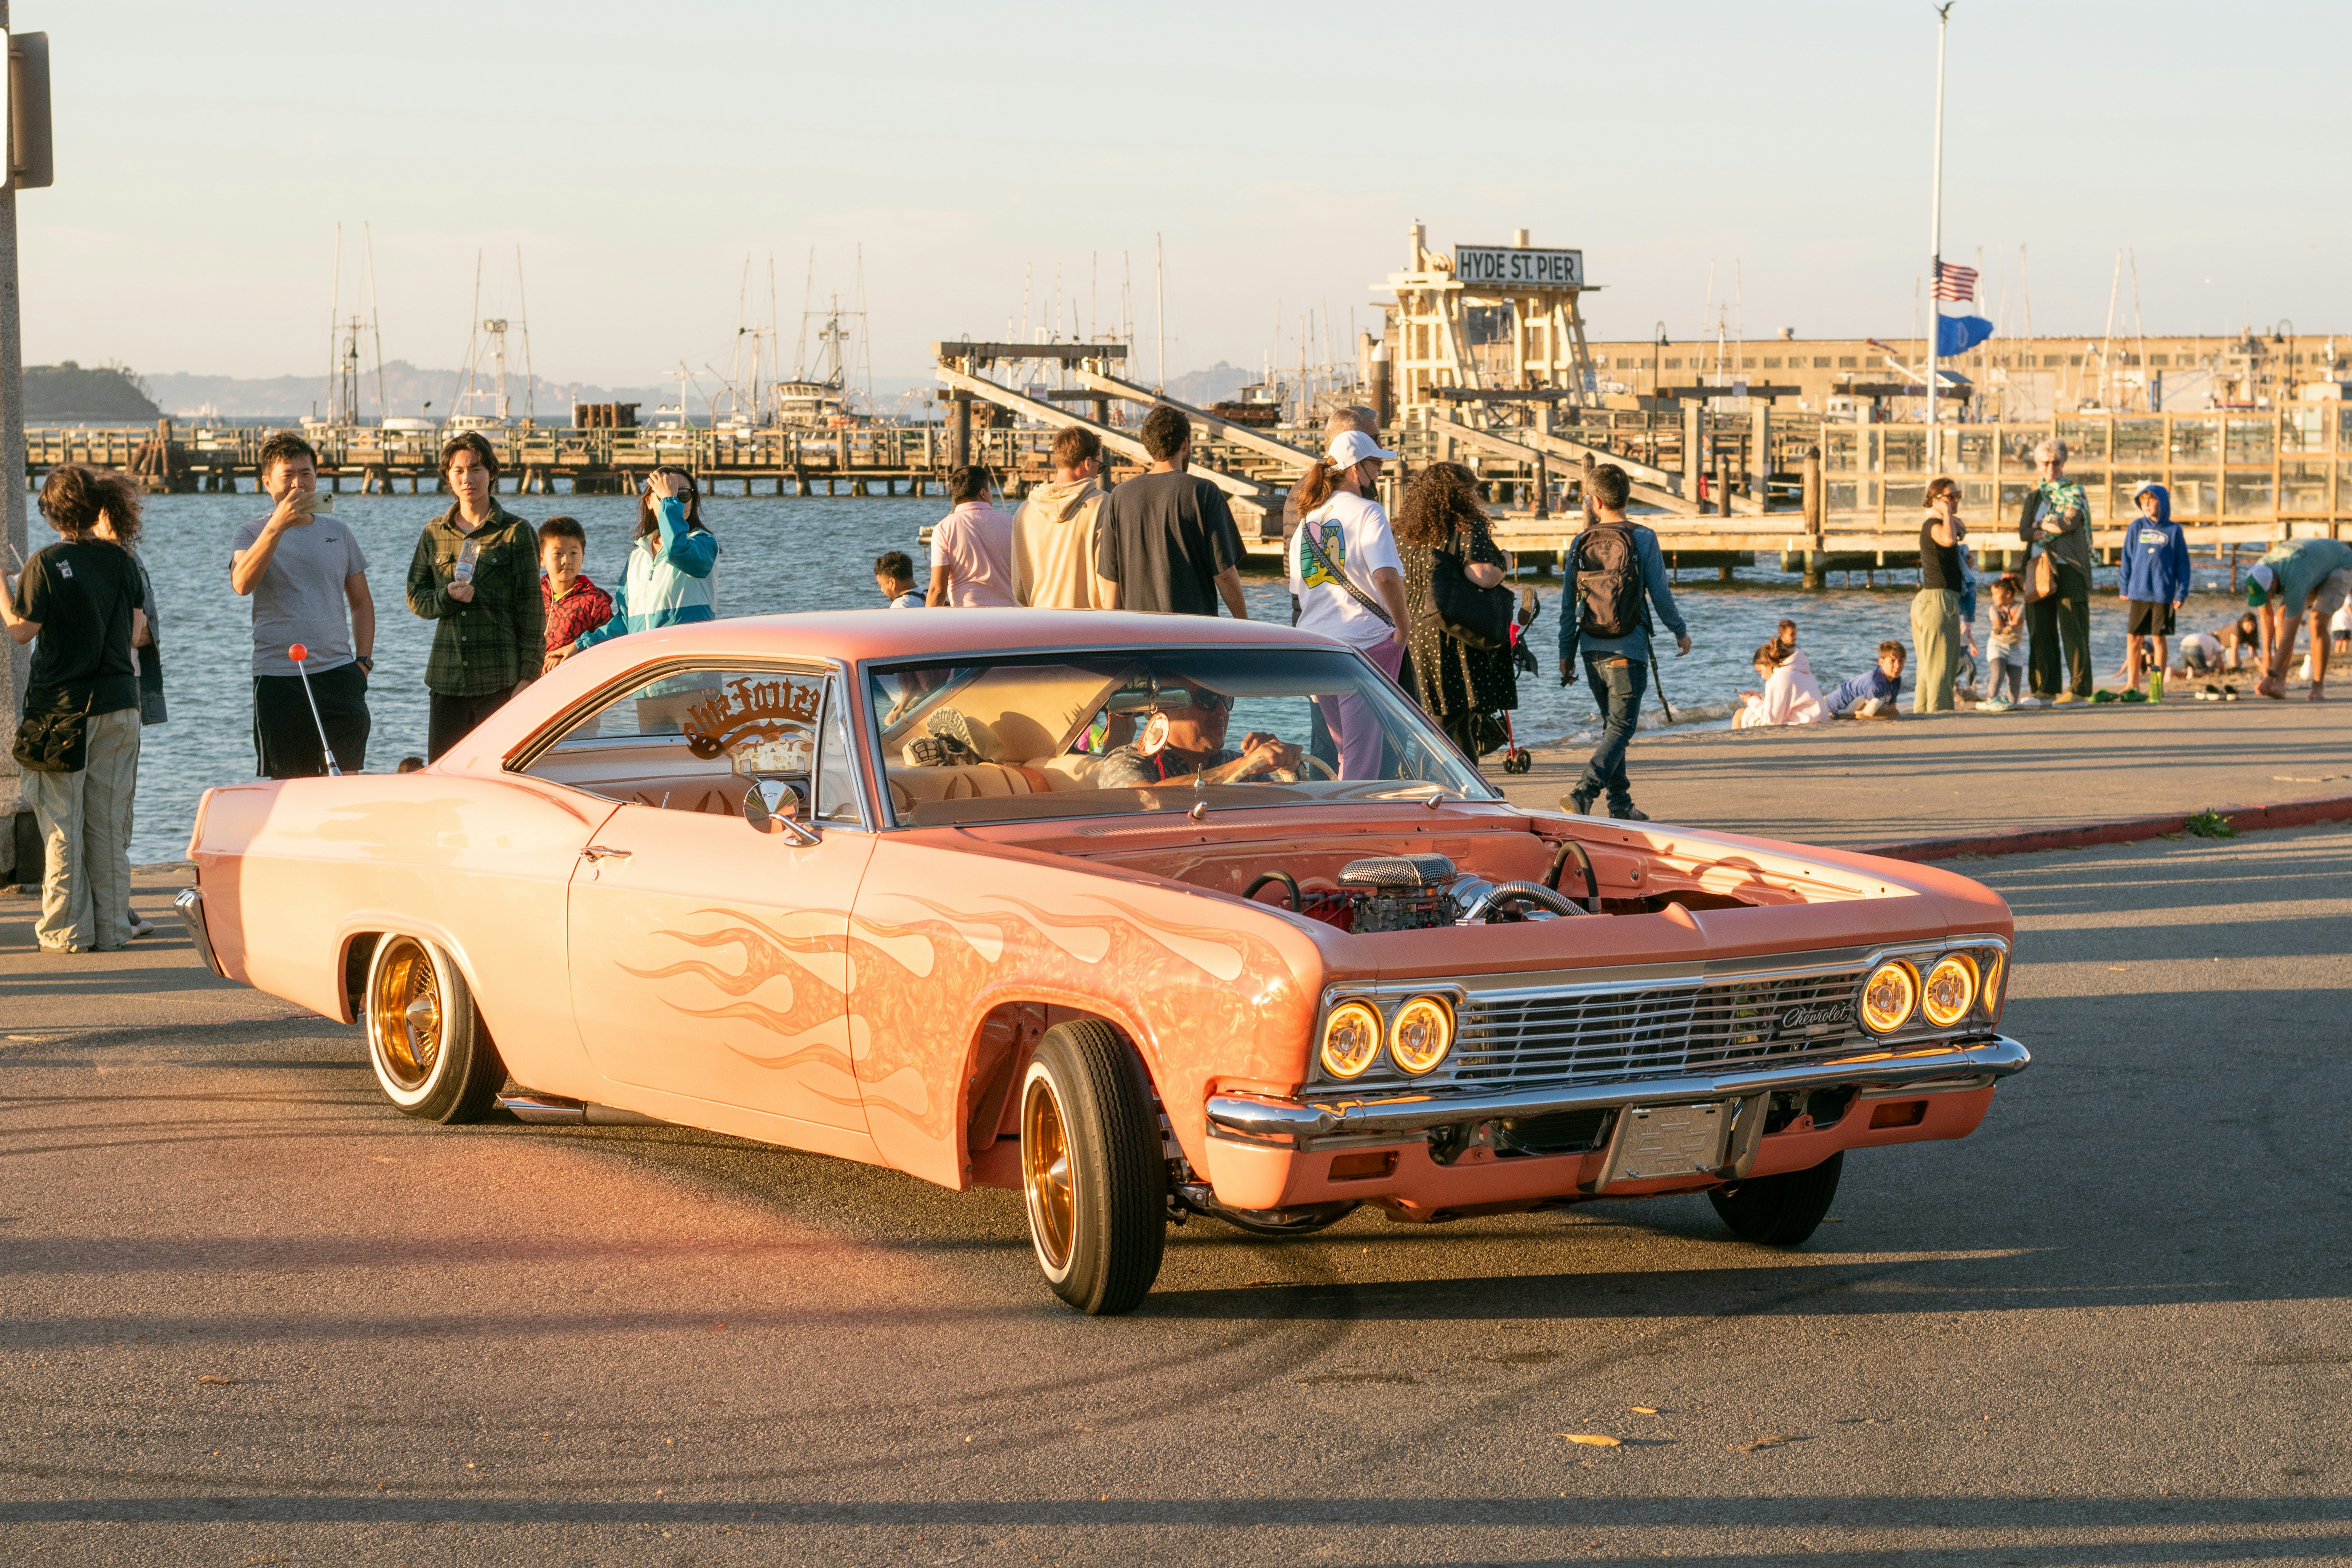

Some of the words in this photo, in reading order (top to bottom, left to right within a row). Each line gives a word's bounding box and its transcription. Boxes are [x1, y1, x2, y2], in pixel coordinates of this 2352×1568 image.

[1460, 252, 1505, 278] HYDE
[1511, 254, 1533, 279] ST.
[1538, 255, 1574, 281] PIER
[1782, 1005, 1851, 1028] Chevrolet
